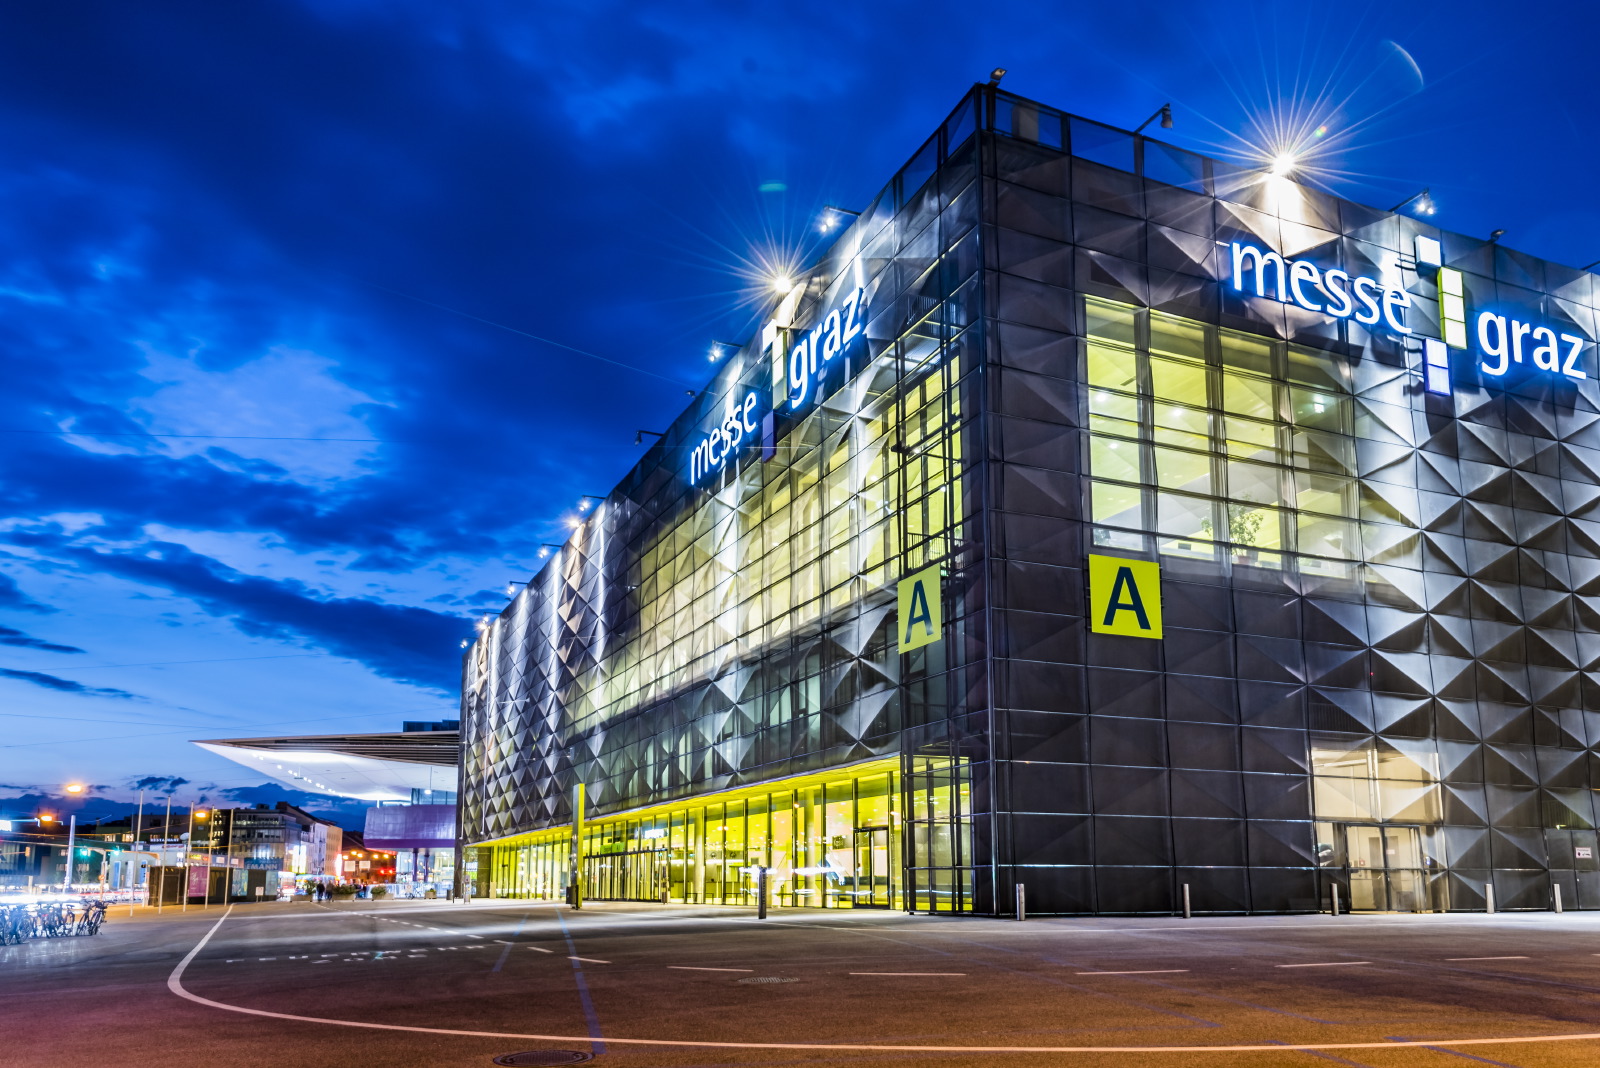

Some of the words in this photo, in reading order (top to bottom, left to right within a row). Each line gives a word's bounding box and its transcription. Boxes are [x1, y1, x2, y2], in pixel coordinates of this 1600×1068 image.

[1232, 242, 1412, 334] messe
[1477, 311, 1587, 380] graz
[691, 392, 757, 485] messe
[790, 287, 864, 409] graz
[905, 579, 934, 644] A
[1103, 566, 1152, 631] A
